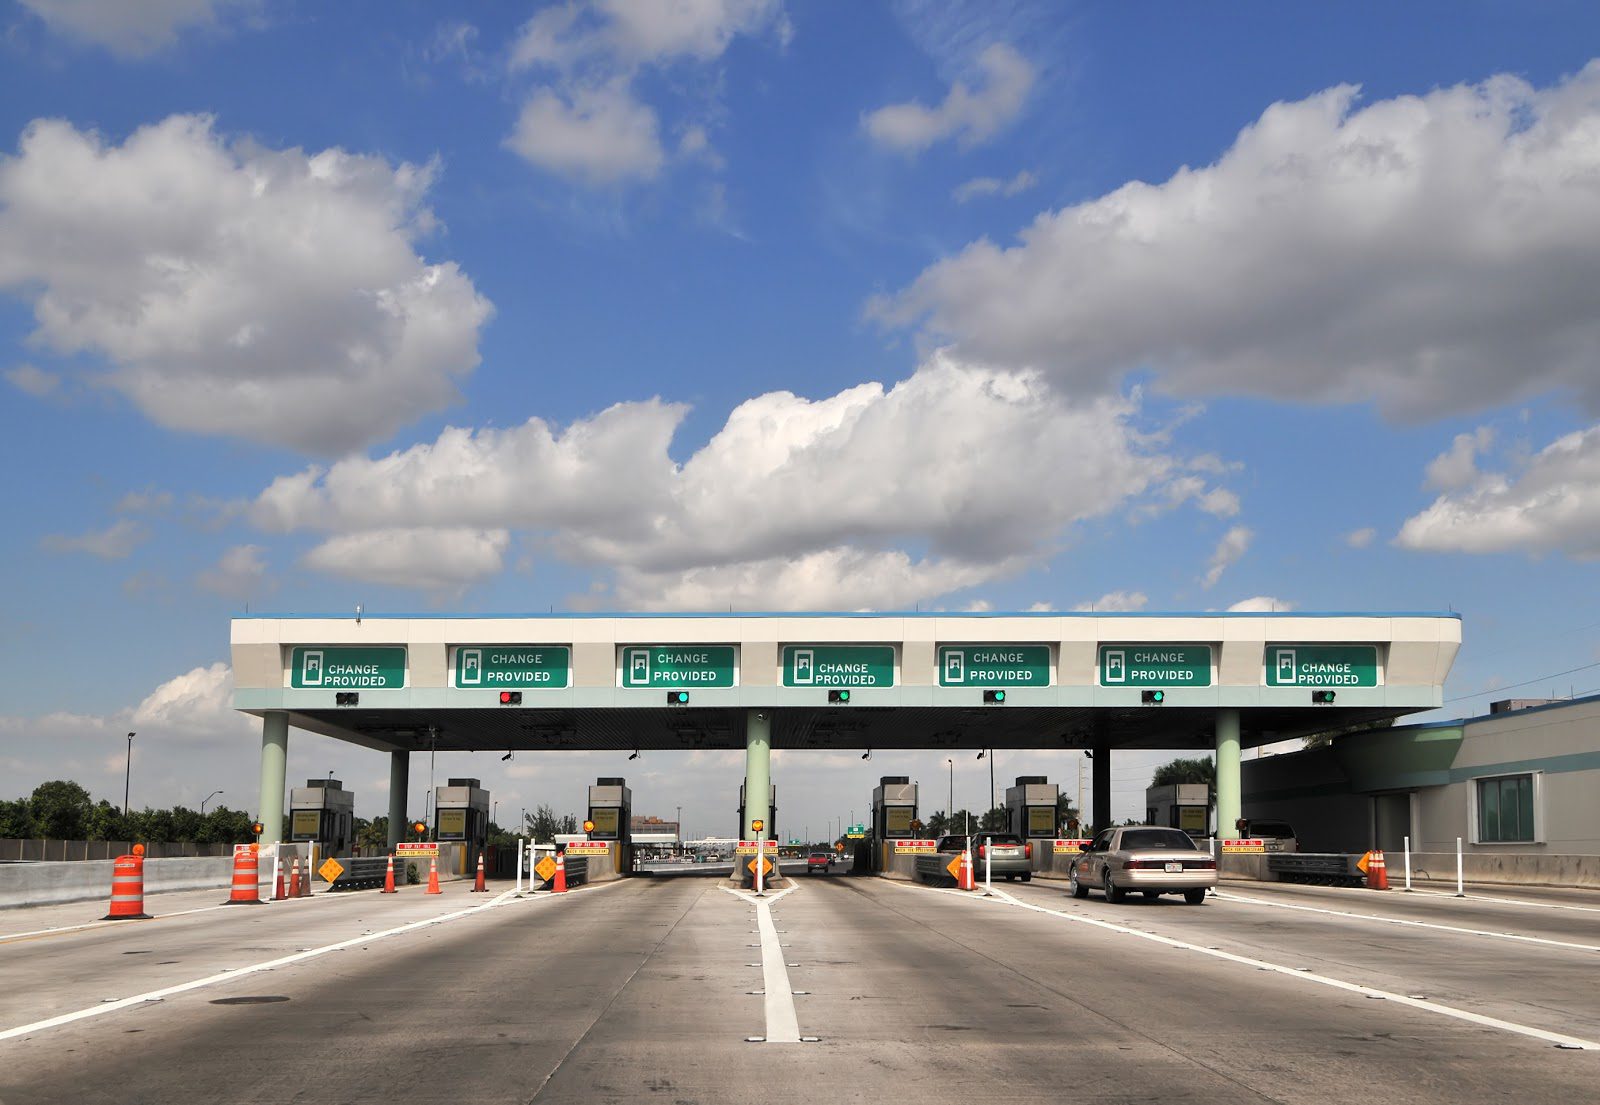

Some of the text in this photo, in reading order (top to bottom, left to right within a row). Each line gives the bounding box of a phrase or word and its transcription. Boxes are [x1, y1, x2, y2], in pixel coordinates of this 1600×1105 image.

[492, 654, 543, 664] CHANGE
[657, 654, 708, 664] CHANGE
[973, 653, 1024, 663] CHANGE
[1134, 653, 1185, 663] CHANGE
[329, 664, 378, 674] CHANGE
[819, 664, 868, 673] CHANGE
[1301, 664, 1351, 673] CHANGE
[487, 672, 550, 682] PROVIDED
[653, 672, 717, 681] PROVIDED
[970, 671, 1033, 680] PROVIDED
[1131, 671, 1193, 680] PROVIDED
[1298, 675, 1359, 685] PROVIDED
[324, 677, 386, 686] PROVIDED
[815, 676, 876, 685] PROVIDED
